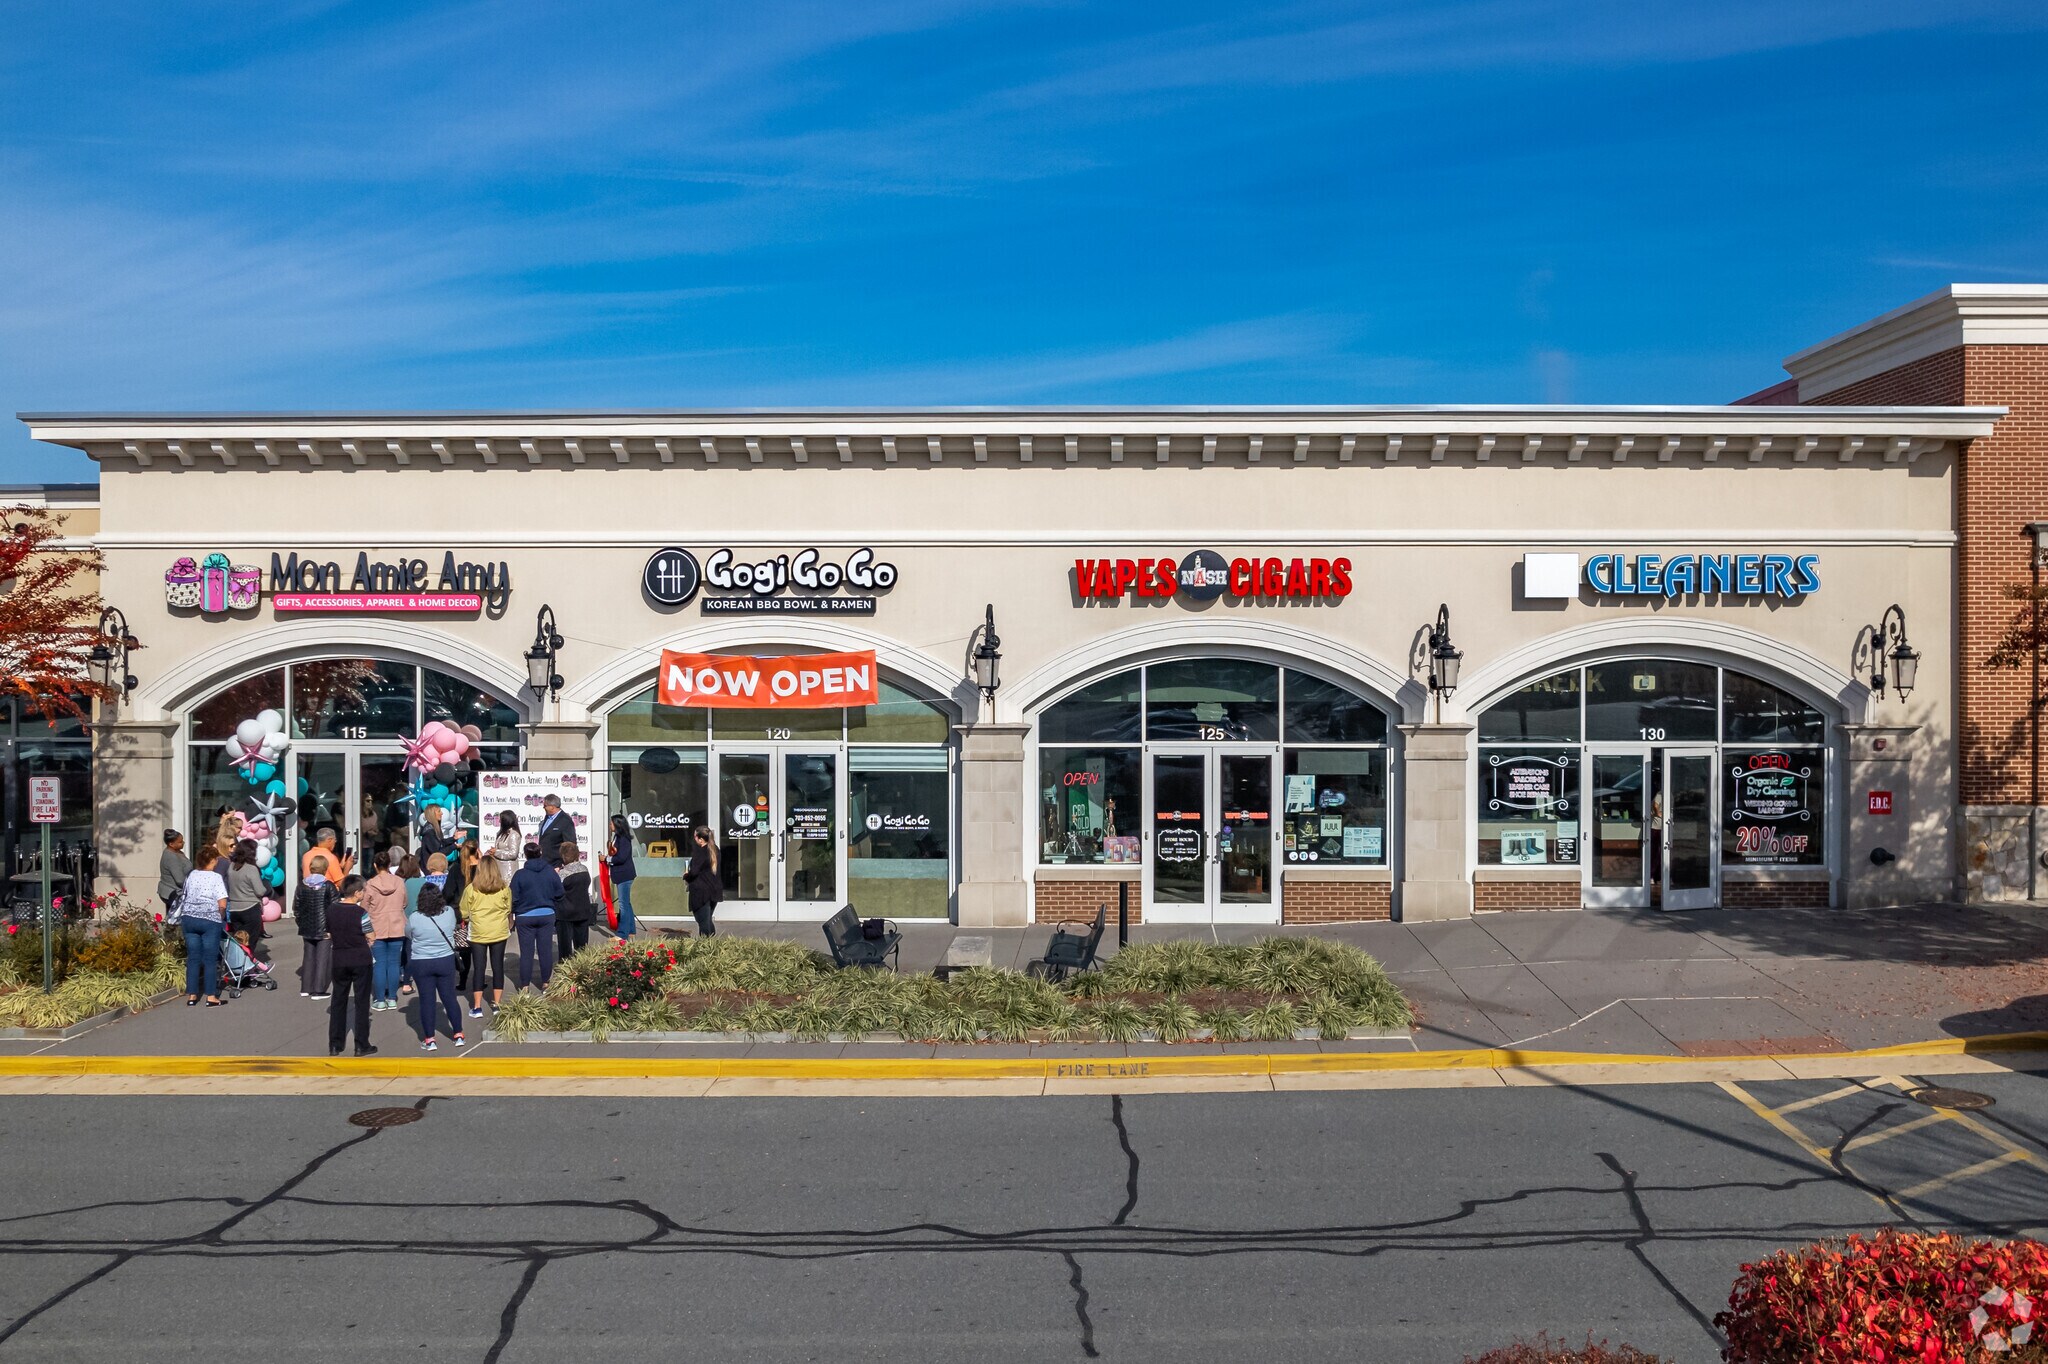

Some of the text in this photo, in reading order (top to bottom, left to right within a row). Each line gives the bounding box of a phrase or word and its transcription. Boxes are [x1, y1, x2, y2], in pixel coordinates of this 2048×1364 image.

[705, 548, 897, 594] Gogi Go Go
[1075, 558, 1177, 597] VAPES
[1229, 557, 1353, 597] CIGARS
[1586, 554, 1822, 599] CLEANERS
[270, 551, 511, 609] Mon Amie Amy
[1181, 569, 1227, 587] NASH
[276, 598, 478, 608] GIFTS, ACCESSORIES, APPAREL & HOME DECOR
[707, 600, 872, 609] KOREAN BBQ BOWL & RAMEN
[667, 664, 870, 697] NOW OPEN
[341, 726, 367, 739] 115
[766, 728, 791, 740] 120
[1198, 728, 1224, 740] 125
[1640, 728, 1666, 741] 130
[1749, 755, 1789, 769] OPEN
[510, 776, 525, 785] Mon
[545, 776, 559, 787] Amy
[1063, 772, 1100, 786] OPEN
[1747, 776, 1778, 787] Organic
[1747, 786, 1796, 797] Dry Cleaning
[644, 813, 690, 825] Gogi Go Go
[883, 814, 930, 826] Gogi Go Go
[728, 828, 743, 837] Gogi
[743, 828, 751, 836] Go
[1736, 826, 1808, 853] 20% OFF
[1057, 1063, 1150, 1077] FIRE LANE
